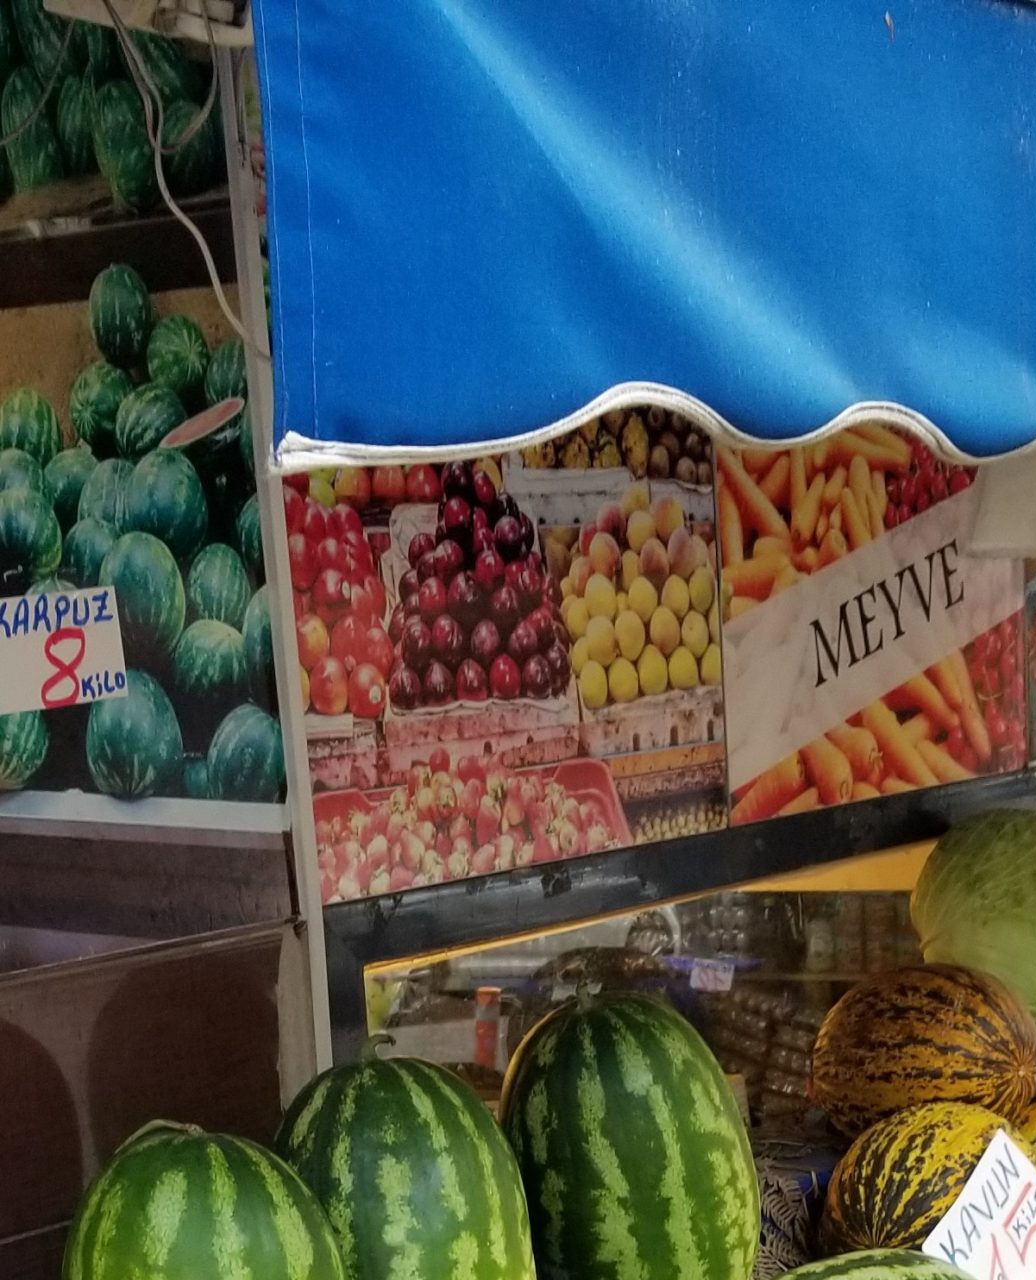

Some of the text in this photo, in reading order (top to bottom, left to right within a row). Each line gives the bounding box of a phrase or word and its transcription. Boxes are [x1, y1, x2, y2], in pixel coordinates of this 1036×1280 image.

[41, 626, 86, 709] 8
[809, 538, 964, 688] MEYVE
[939, 1142, 1020, 1264] KAVUN
